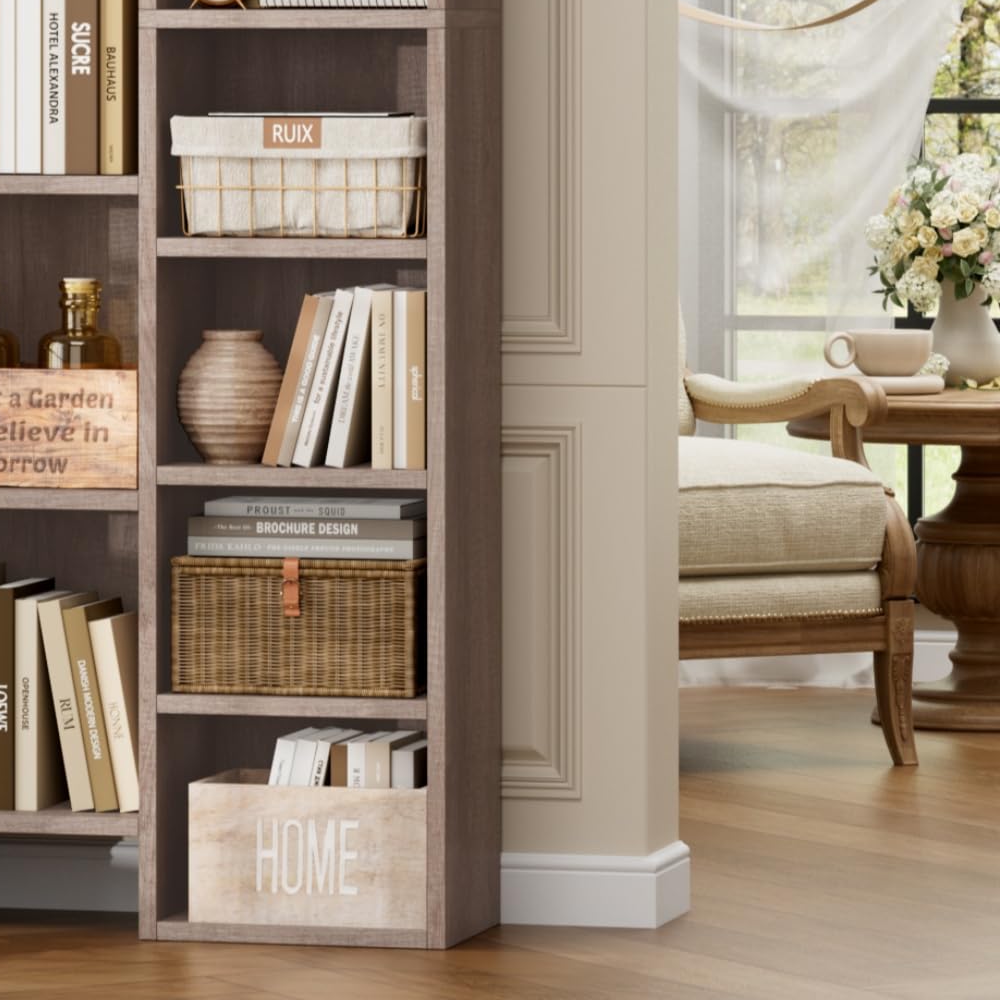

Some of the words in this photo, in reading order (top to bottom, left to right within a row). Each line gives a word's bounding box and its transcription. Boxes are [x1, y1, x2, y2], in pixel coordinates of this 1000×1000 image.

[49, 12, 58, 49] HOTEL
[71, 22, 91, 75] SUCRE
[49, 53, 59, 124] ALEXANDRA
[106, 47, 116, 102] BAUHAUS
[272, 124, 313, 143] RUIX
[9, 392, 21, 408] a
[29, 388, 114, 409] Garden
[84, 421, 109, 442] in
[246, 505, 291, 515] PROUST
[318, 507, 346, 517] SQUID
[256, 521, 315, 534] BROCHURE
[318, 523, 359, 535] DESIGN
[77, 659, 89, 689] DANISH
[83, 691, 96, 728] MODERN
[89, 729, 101, 760] DESIGN
[256, 819, 360, 895] HOME
